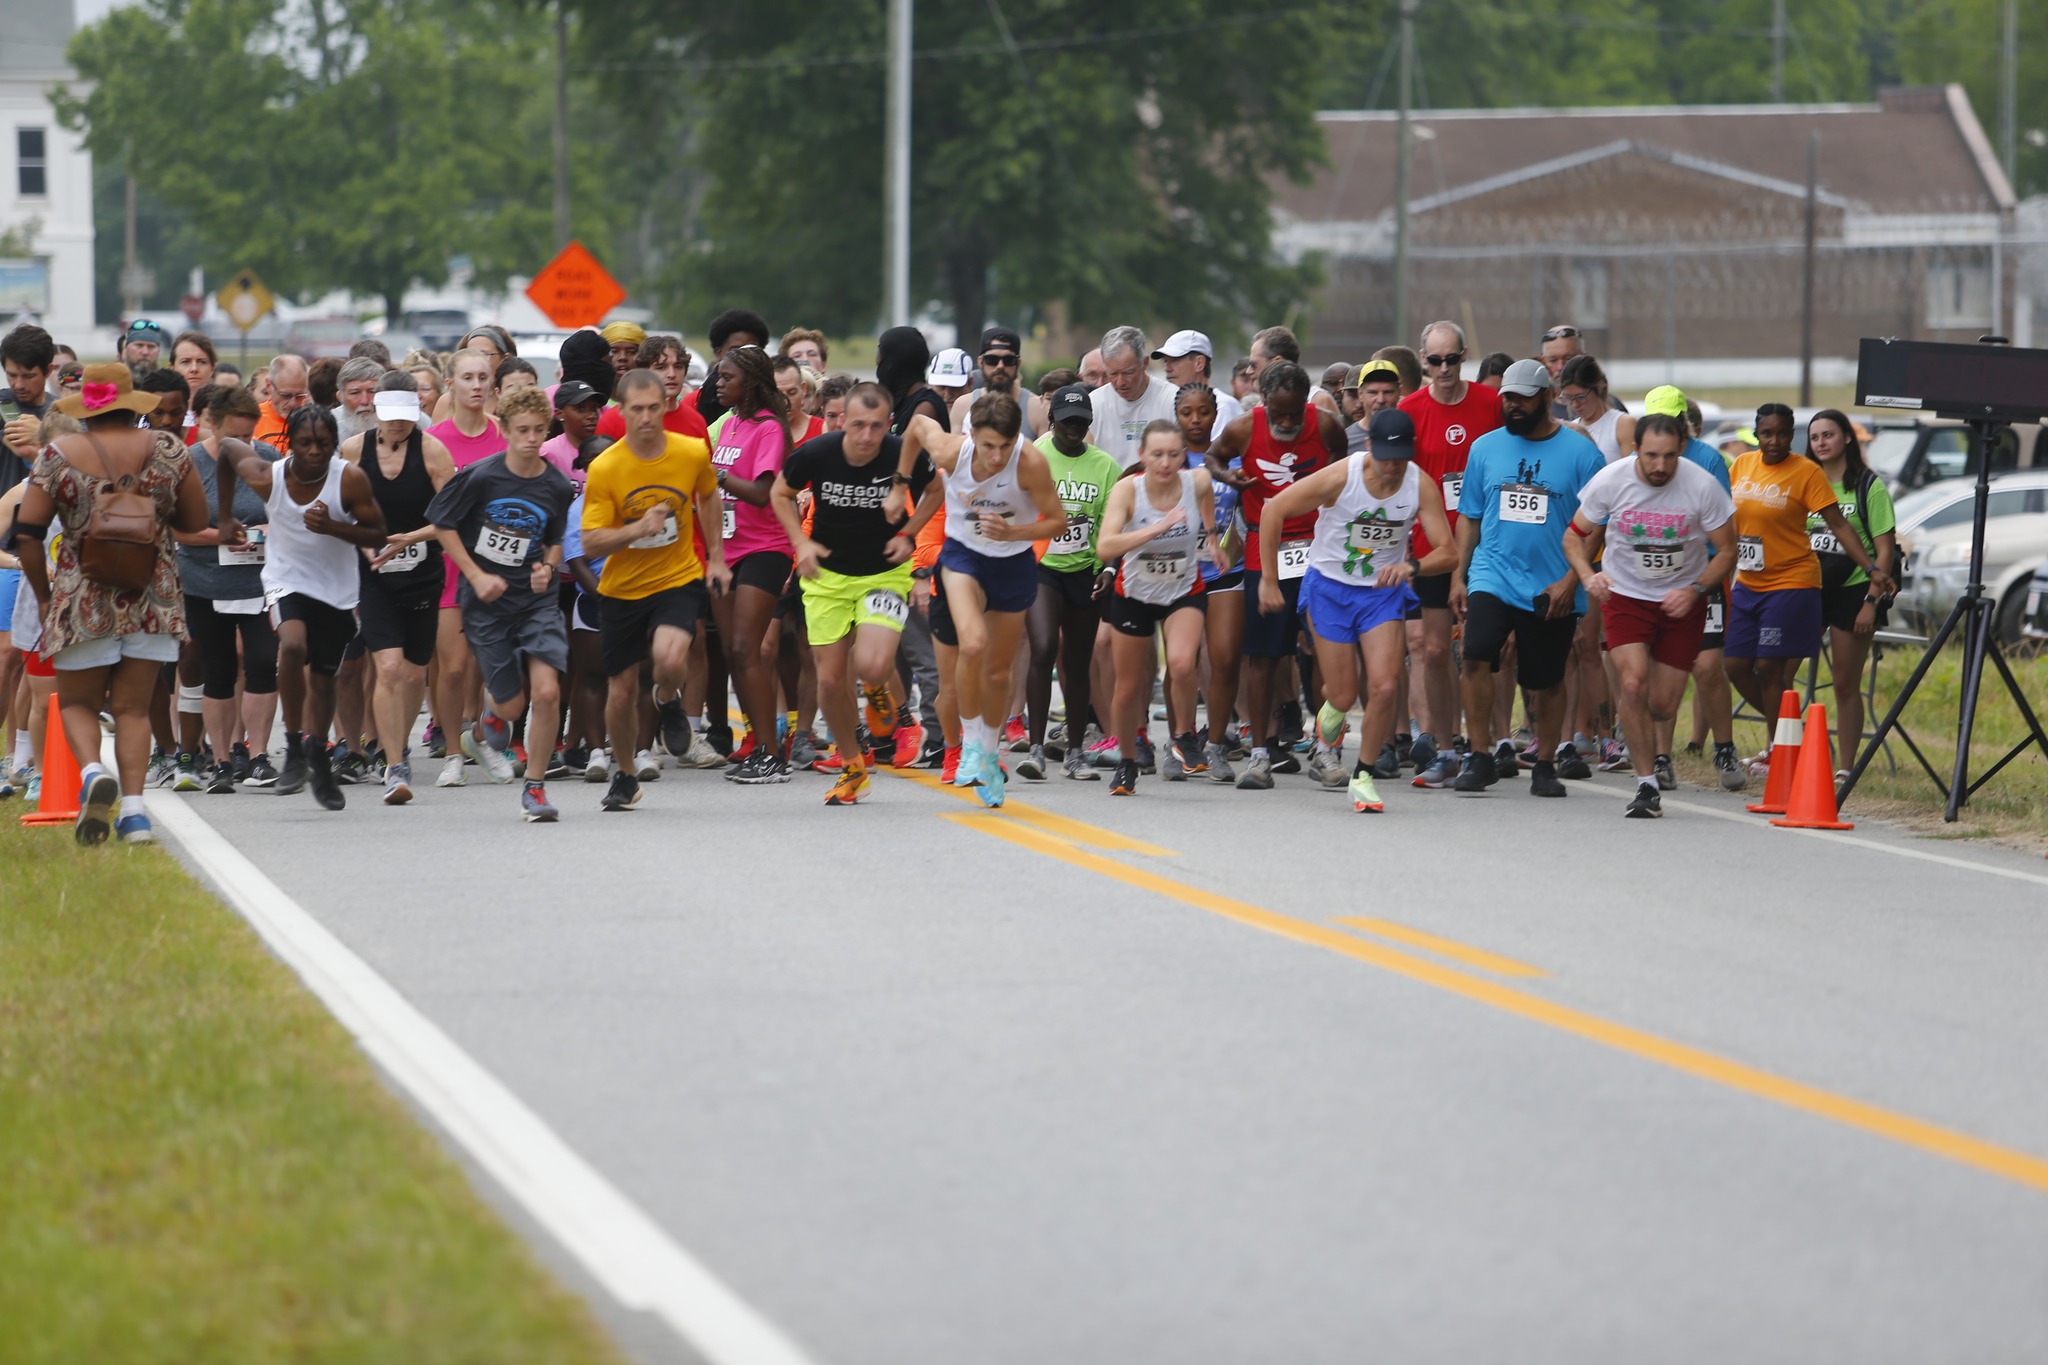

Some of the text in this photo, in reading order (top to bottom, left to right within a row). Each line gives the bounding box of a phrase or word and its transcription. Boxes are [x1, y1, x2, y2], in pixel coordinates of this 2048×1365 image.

[821, 481, 890, 498] OREGON
[1054, 480, 1099, 503] AMP
[1508, 493, 1539, 511] 556
[1621, 509, 1687, 528] CHERRY
[1360, 526, 1394, 541] 523
[1615, 521, 1691, 539] BLSSM
[487, 533, 521, 555] 574
[1813, 535, 1838, 552] 691
[1643, 554, 1674, 568] 551
